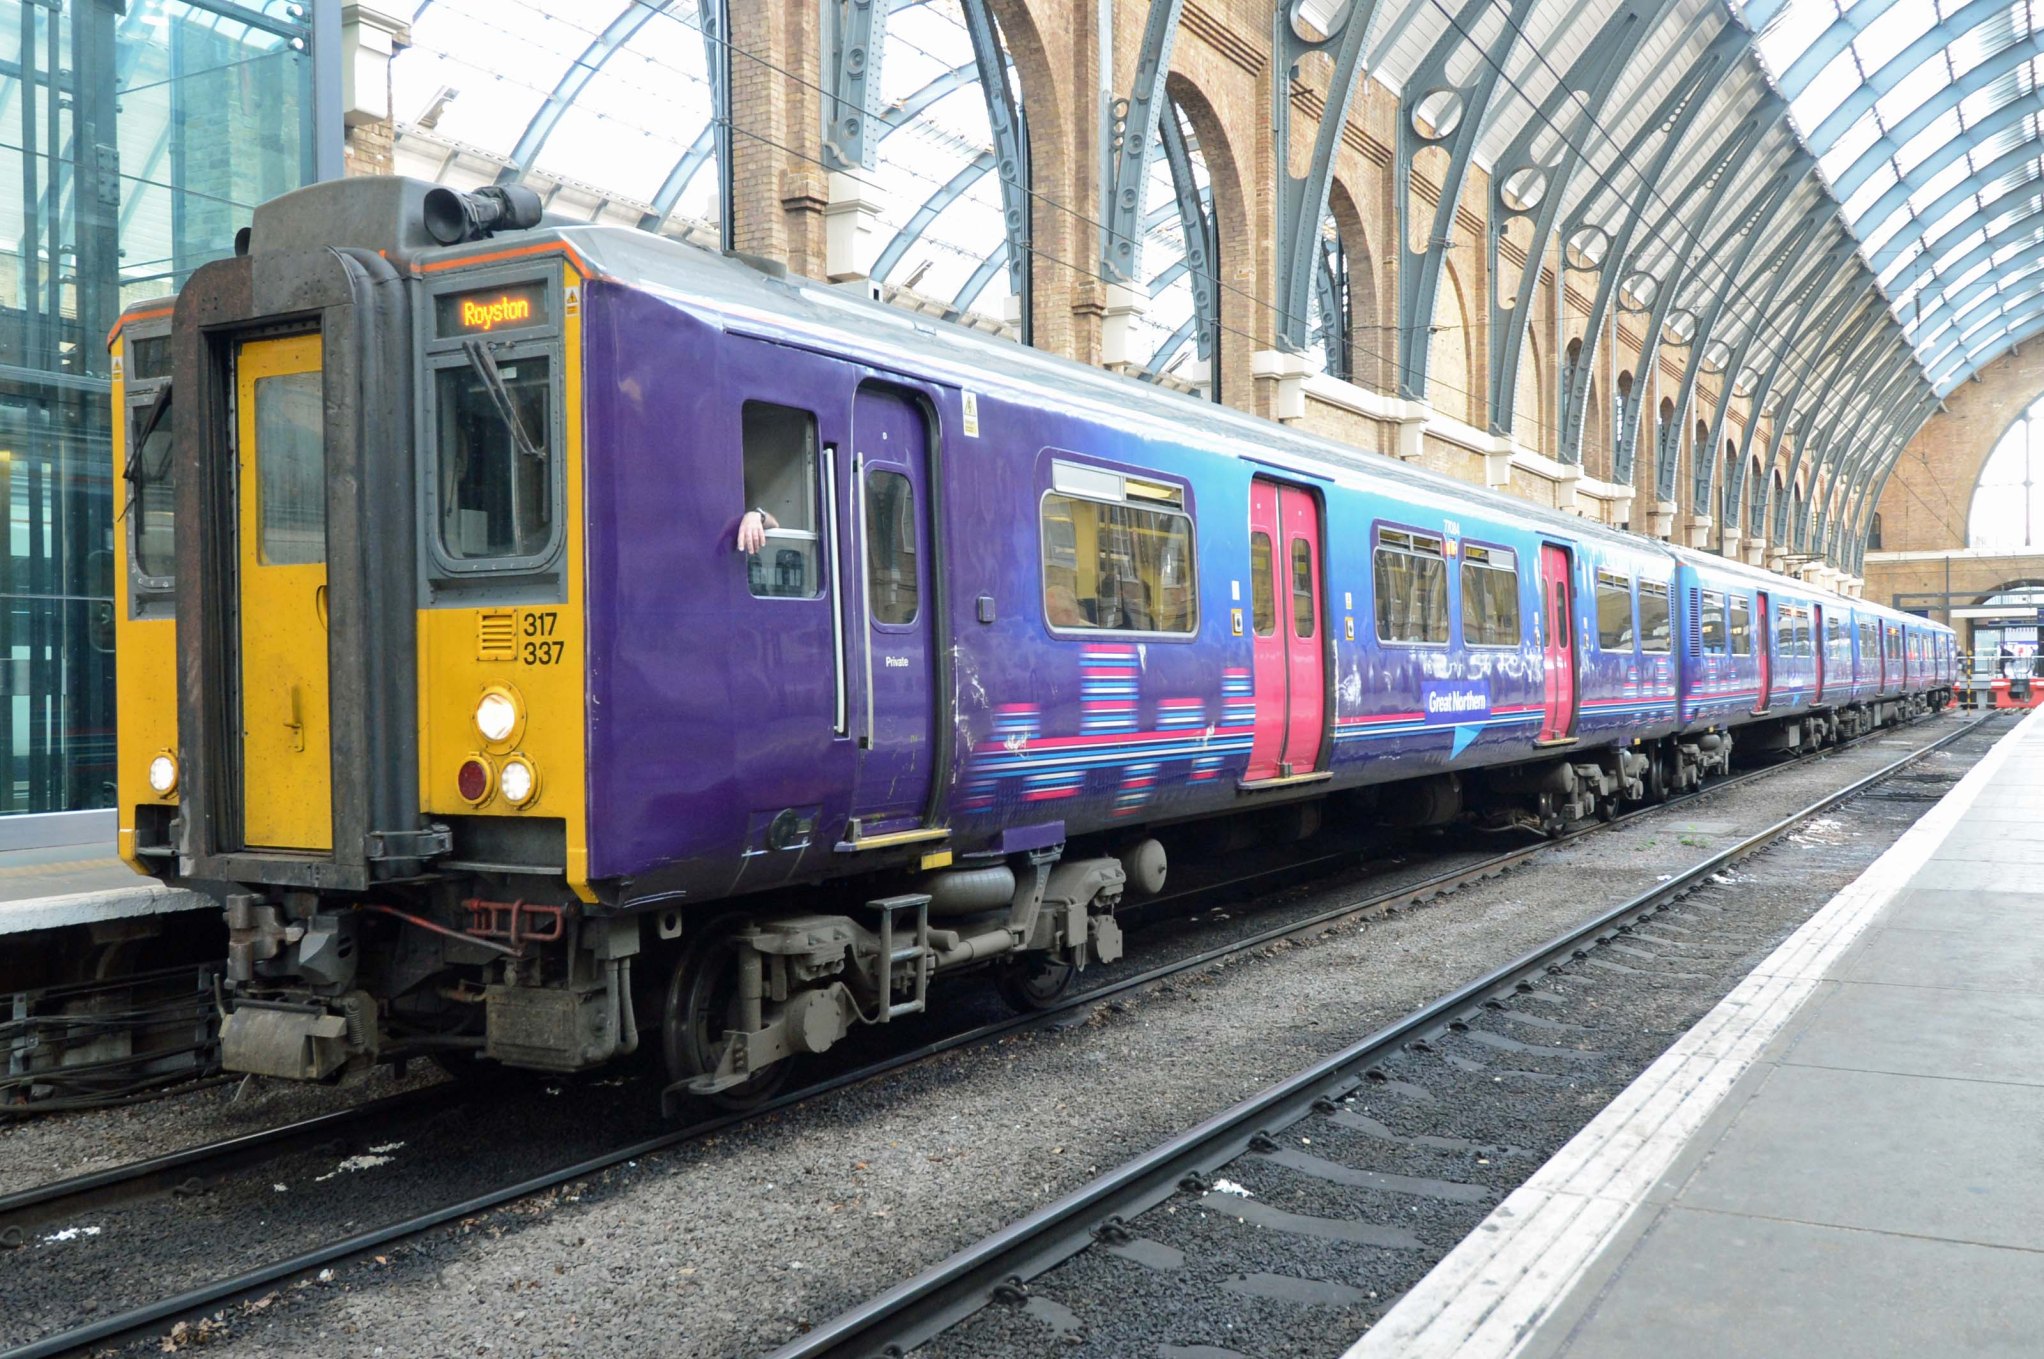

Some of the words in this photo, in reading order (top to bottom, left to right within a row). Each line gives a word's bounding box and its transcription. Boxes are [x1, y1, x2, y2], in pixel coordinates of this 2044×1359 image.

[463, 296, 529, 330] Royston
[523, 612, 558, 637] 317
[523, 640, 565, 666] 337
[885, 655, 909, 668] Private
[1429, 690, 1452, 713] Great
[1452, 689, 1486, 712] Northern
